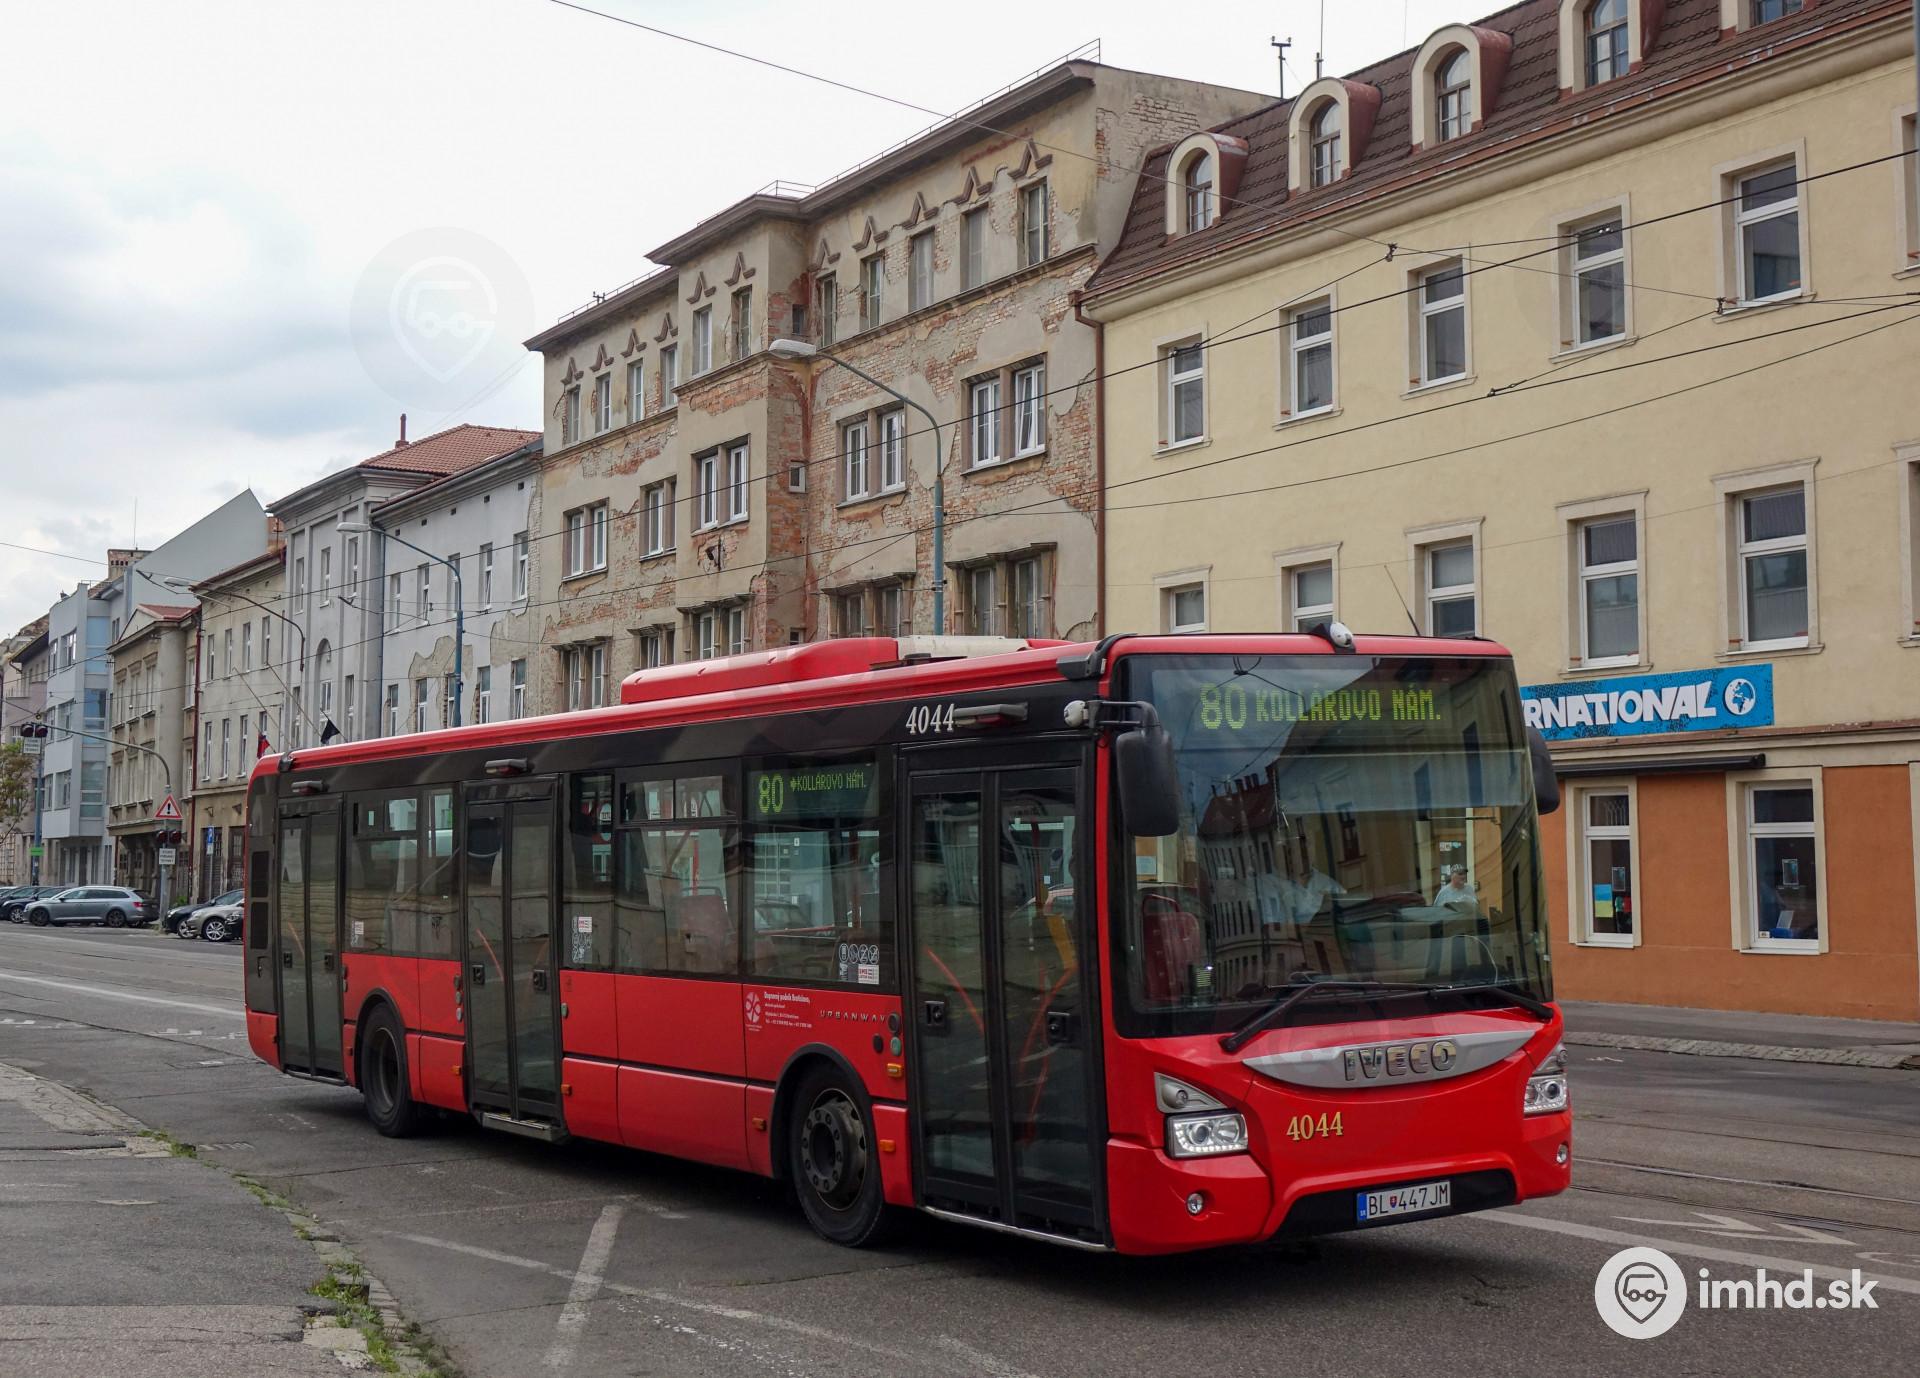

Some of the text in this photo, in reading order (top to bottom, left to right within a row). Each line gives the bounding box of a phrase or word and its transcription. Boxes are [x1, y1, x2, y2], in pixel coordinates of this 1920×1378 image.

[905, 703, 954, 735] 4044
[1200, 683, 1441, 729] 80 KOLLÁROVO NÁM.
[1520, 681, 1716, 729] RNATIONAL
[758, 774, 784, 814] 80
[797, 773, 843, 791] KOLLÁROVO
[820, 1009, 886, 1023] URBANWAY
[1344, 1038, 1457, 1081] IVECO
[1287, 1111, 1343, 1141] 4044
